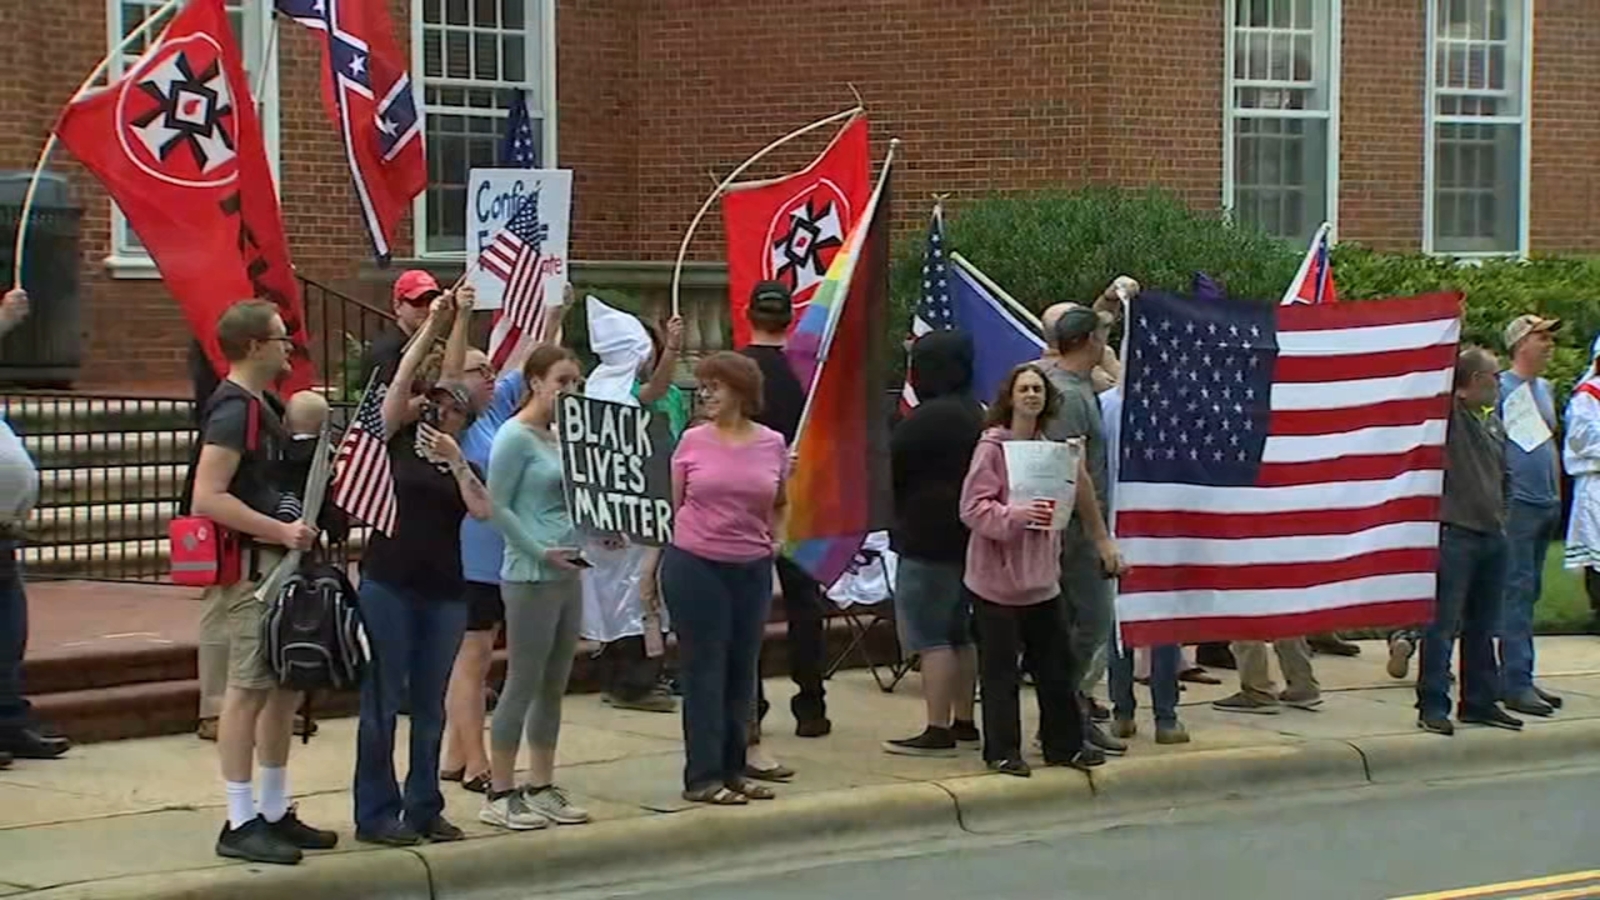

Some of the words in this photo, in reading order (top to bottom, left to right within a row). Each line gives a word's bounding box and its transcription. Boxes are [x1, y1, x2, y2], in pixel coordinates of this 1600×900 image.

[564, 396, 653, 458] BLACK
[568, 443, 646, 494] LIVES
[574, 487, 673, 544] MATTER
